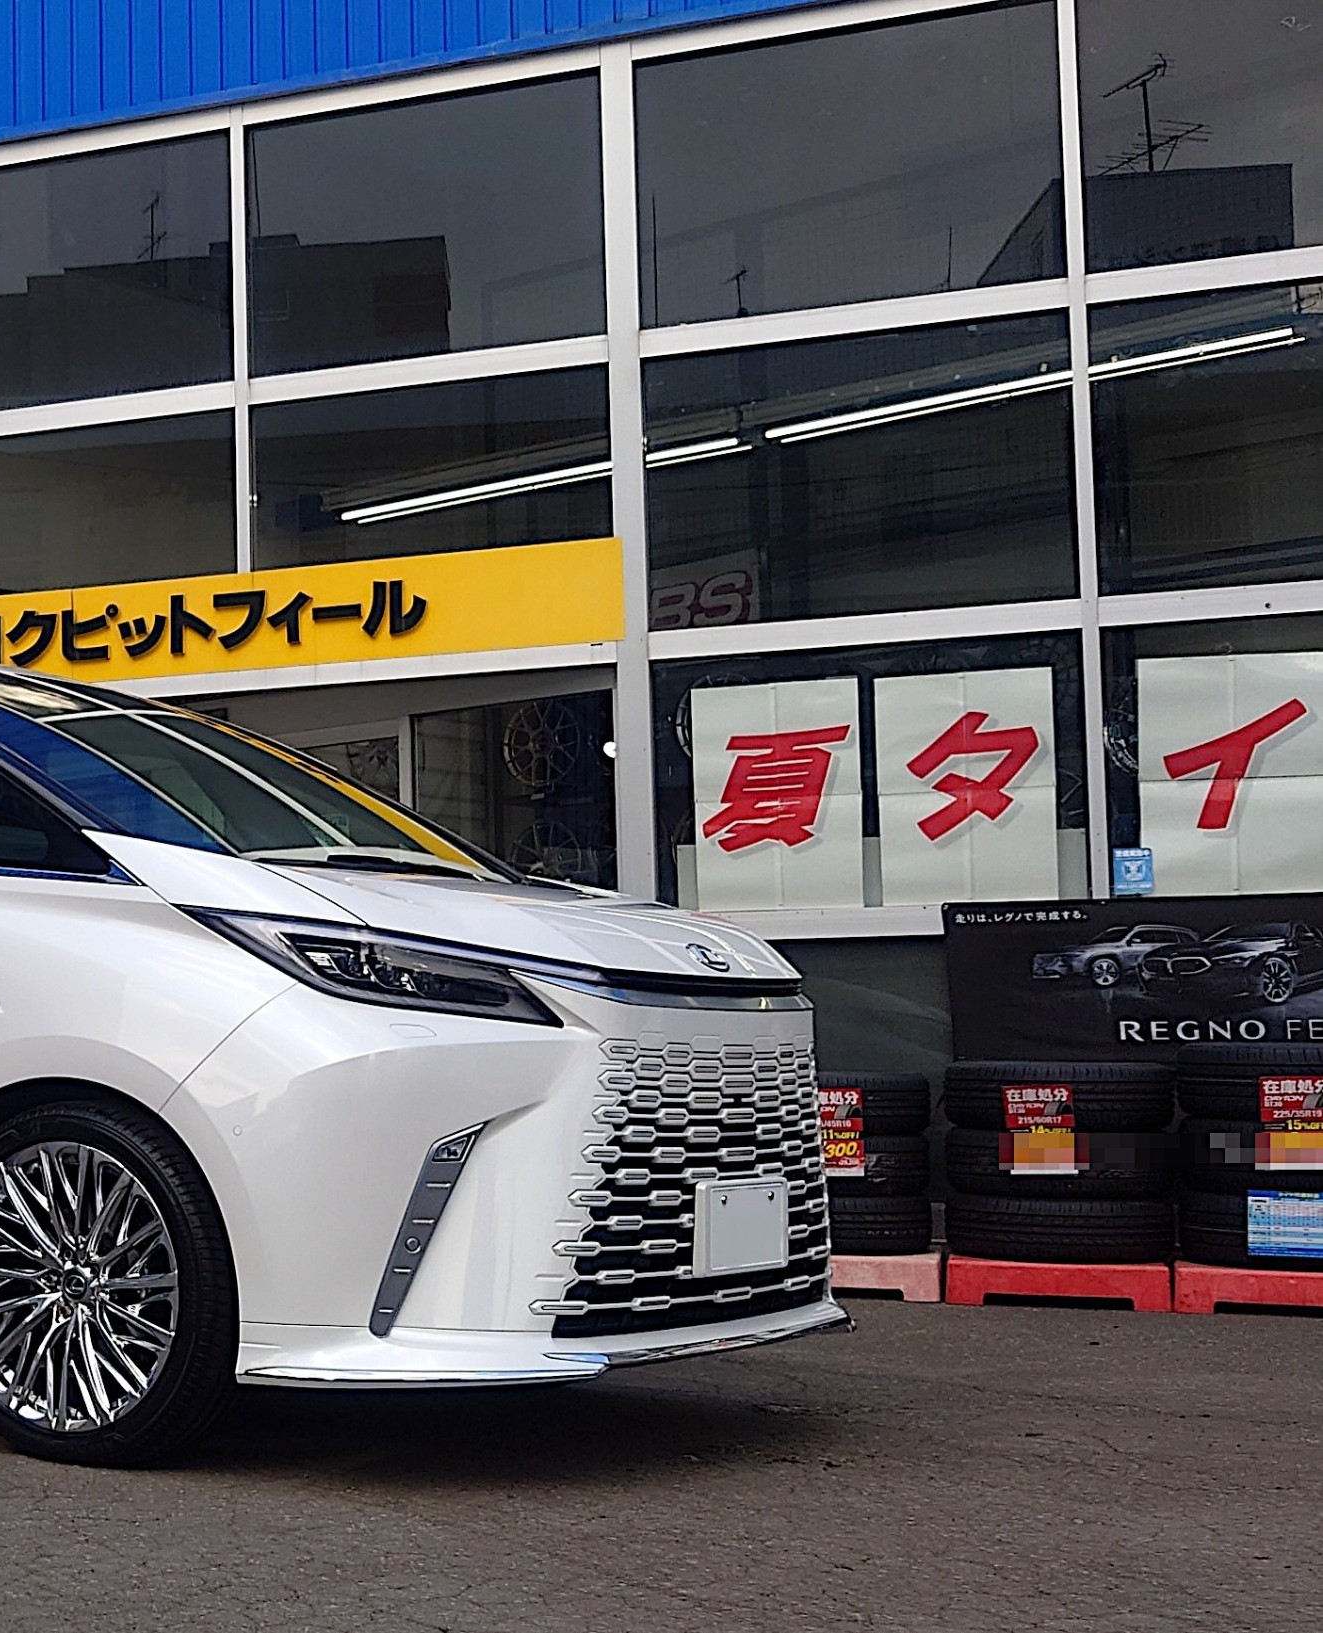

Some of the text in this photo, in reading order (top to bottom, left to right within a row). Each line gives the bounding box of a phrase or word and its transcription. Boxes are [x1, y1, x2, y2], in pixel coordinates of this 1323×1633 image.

[955, 910, 1087, 924] 走りは、レグノで完成する。
[1119, 1020, 1266, 1042] REGNO
[1006, 1088, 1068, 1102] 在庫処分
